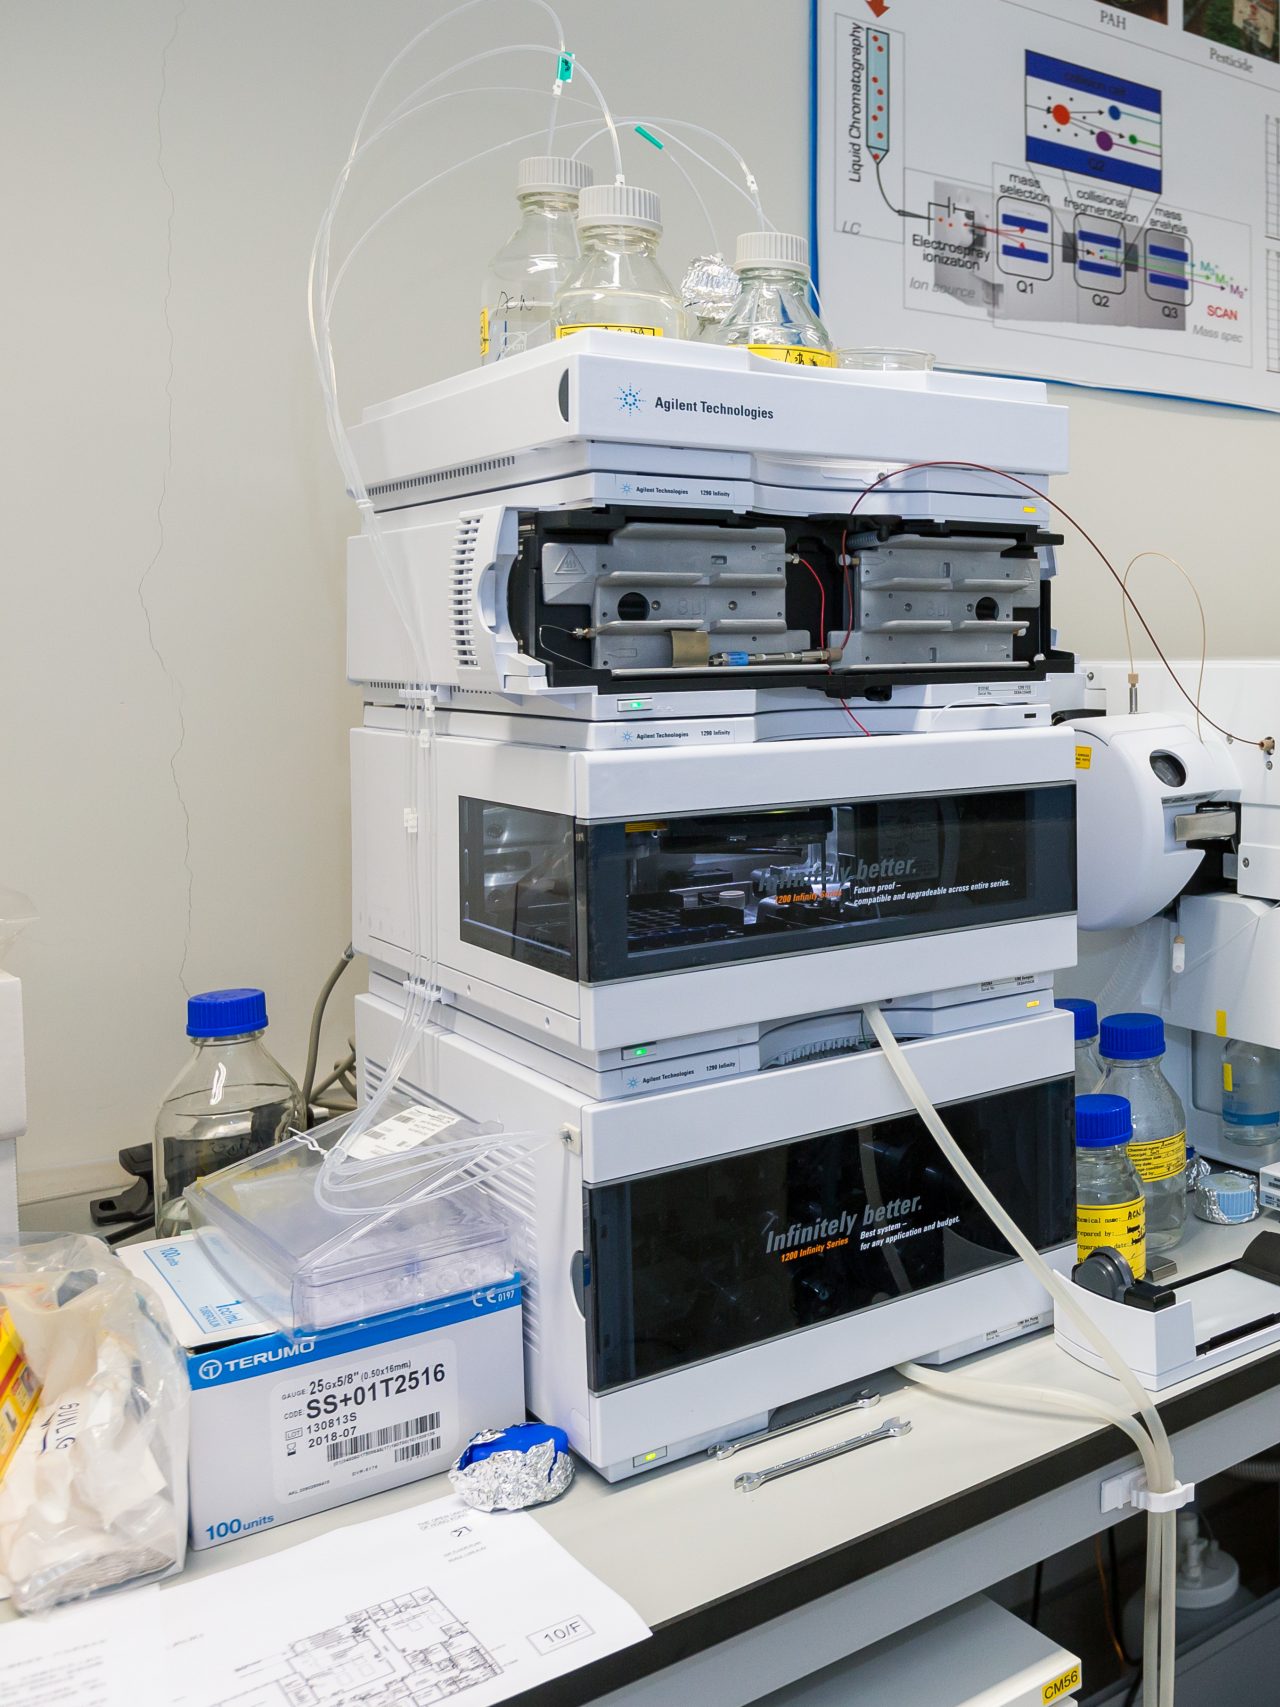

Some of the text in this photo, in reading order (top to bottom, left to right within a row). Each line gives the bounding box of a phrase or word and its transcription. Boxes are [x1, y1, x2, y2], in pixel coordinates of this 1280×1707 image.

[1099, 9, 1126, 30] PAH
[1209, 48, 1253, 73] Pesticide
[849, 22, 864, 182] Liquid Chromatography
[1009, 173, 1041, 189] mass
[1000, 183, 1050, 203] selection
[1076, 189, 1127, 208] collisional
[1064, 197, 1139, 223] fragmentation
[1154, 206, 1182, 222] mass
[841, 221, 861, 236] LC
[1150, 217, 1188, 234] analysis
[912, 234, 990, 262] Electrospray
[923, 252, 980, 271] ionization
[909, 277, 976, 299] Ion source
[1016, 280, 1034, 295] Q1
[1092, 294, 1110, 307] Q2
[1162, 305, 1178, 318] Q3
[1207, 304, 1238, 320] SCAN
[1193, 324, 1243, 343] Mass spec
[655, 397, 774, 420] Agilent Technologies
[636, 486, 655, 494] Agilent
[655, 487, 689, 496] Technologies
[712, 490, 731, 498] Infinity
[656, 731, 689, 739] Technologies
[856, 857, 917, 880] better.
[775, 894, 791, 905] 1200
[792, 891, 818, 904] Infinity
[853, 879, 1011, 907] compatible and upgradeable across entire series.
[854, 884, 876, 895] Future
[877, 882, 896, 894] proof
[643, 1074, 661, 1084] Agilent
[662, 1069, 694, 1080] Technologies
[765, 1195, 923, 1254] Infinitely better.
[860, 1228, 876, 1240] Best
[876, 1222, 901, 1237] system
[860, 1214, 961, 1252] for any application and budget.
[781, 1237, 849, 1263] 1200 Infinity Series
[498, 1290, 515, 1302] 0197
[224, 1341, 315, 1372] TERUMO
[281, 1359, 412, 1400] GAUGE: 25Gx5/8" (0.50x16mm)
[283, 1363, 446, 1420] CODE: SS+01T2516
[306, 1412, 357, 1434] 130813S
[308, 1426, 357, 1449] 2018-07
[544, 1621, 581, 1644] 10/F
[1044, 1671, 1078, 1699] CM56
